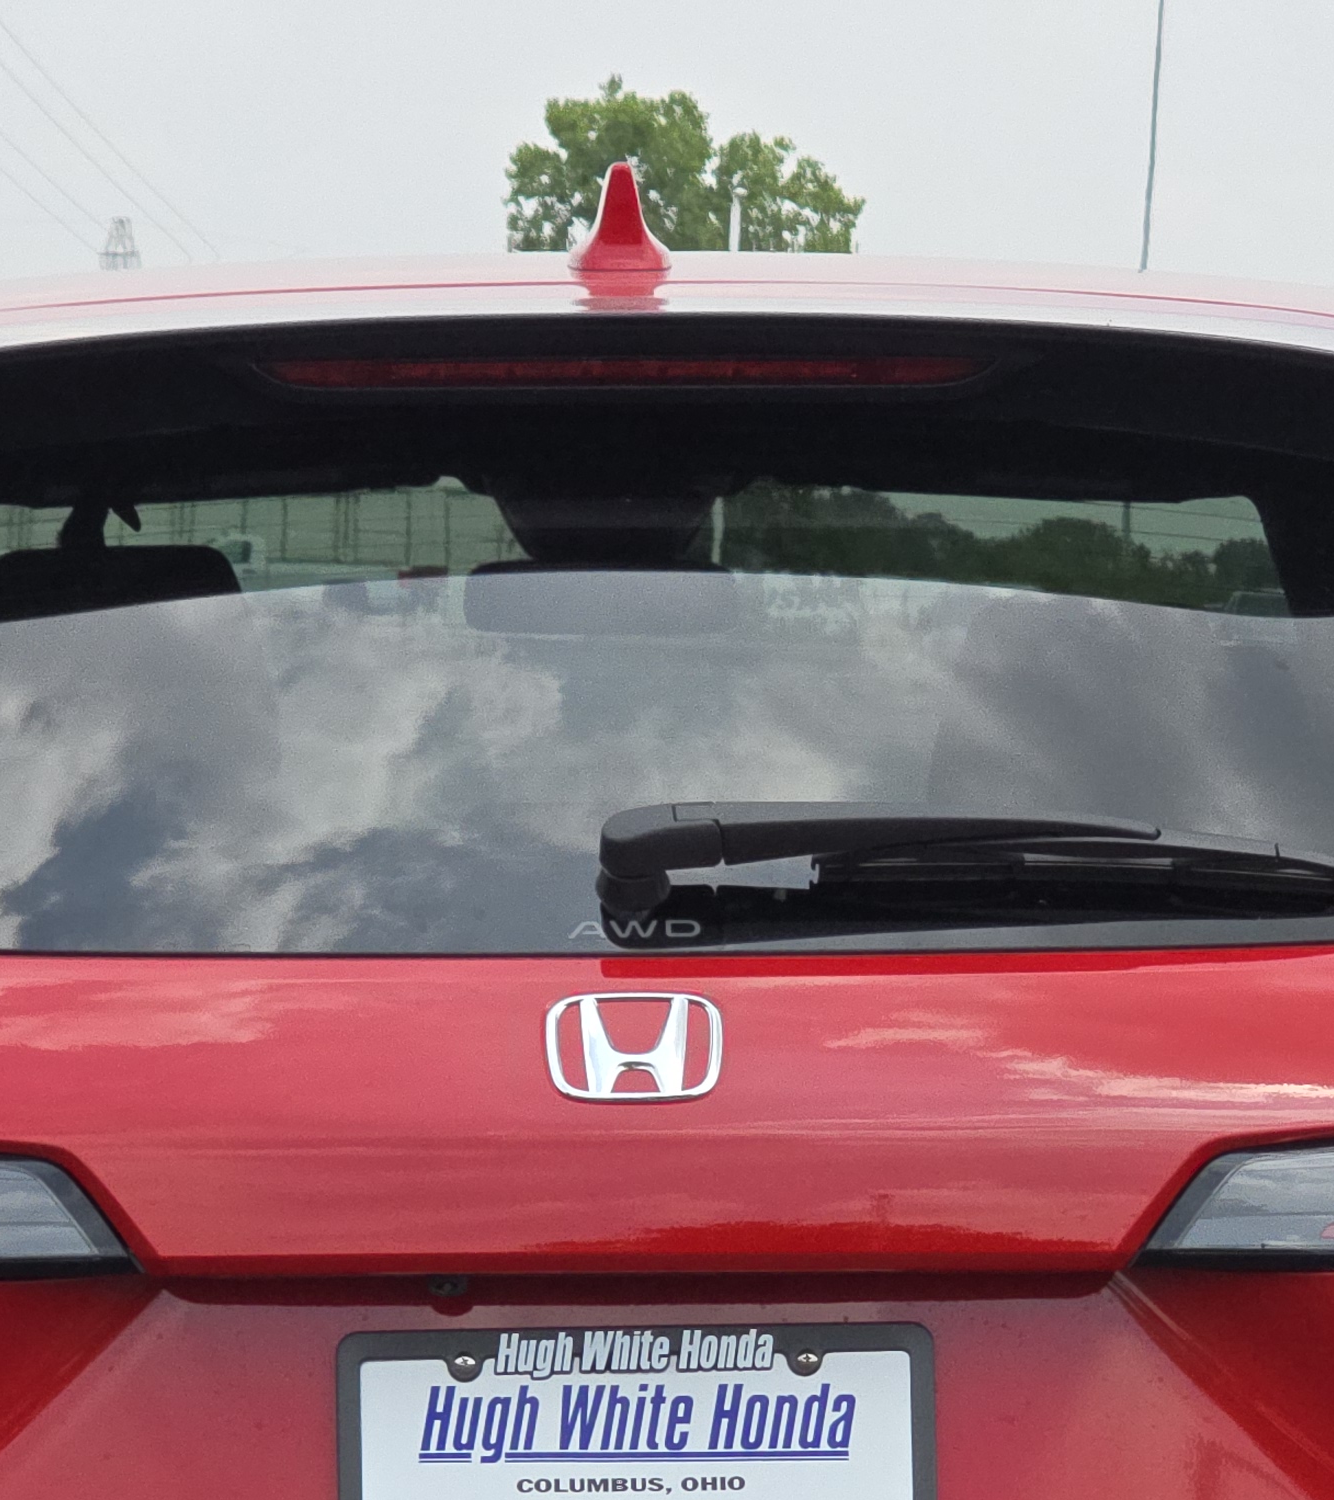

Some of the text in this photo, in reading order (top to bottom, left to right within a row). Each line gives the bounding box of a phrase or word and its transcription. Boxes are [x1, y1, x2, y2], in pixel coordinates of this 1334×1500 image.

[568, 919, 701, 939] AWD
[496, 1328, 775, 1377] Hugh White Honda
[420, 1383, 857, 1463] Hugh White Honda
[516, 1475, 747, 1495] COLUMBUS, OHIO
